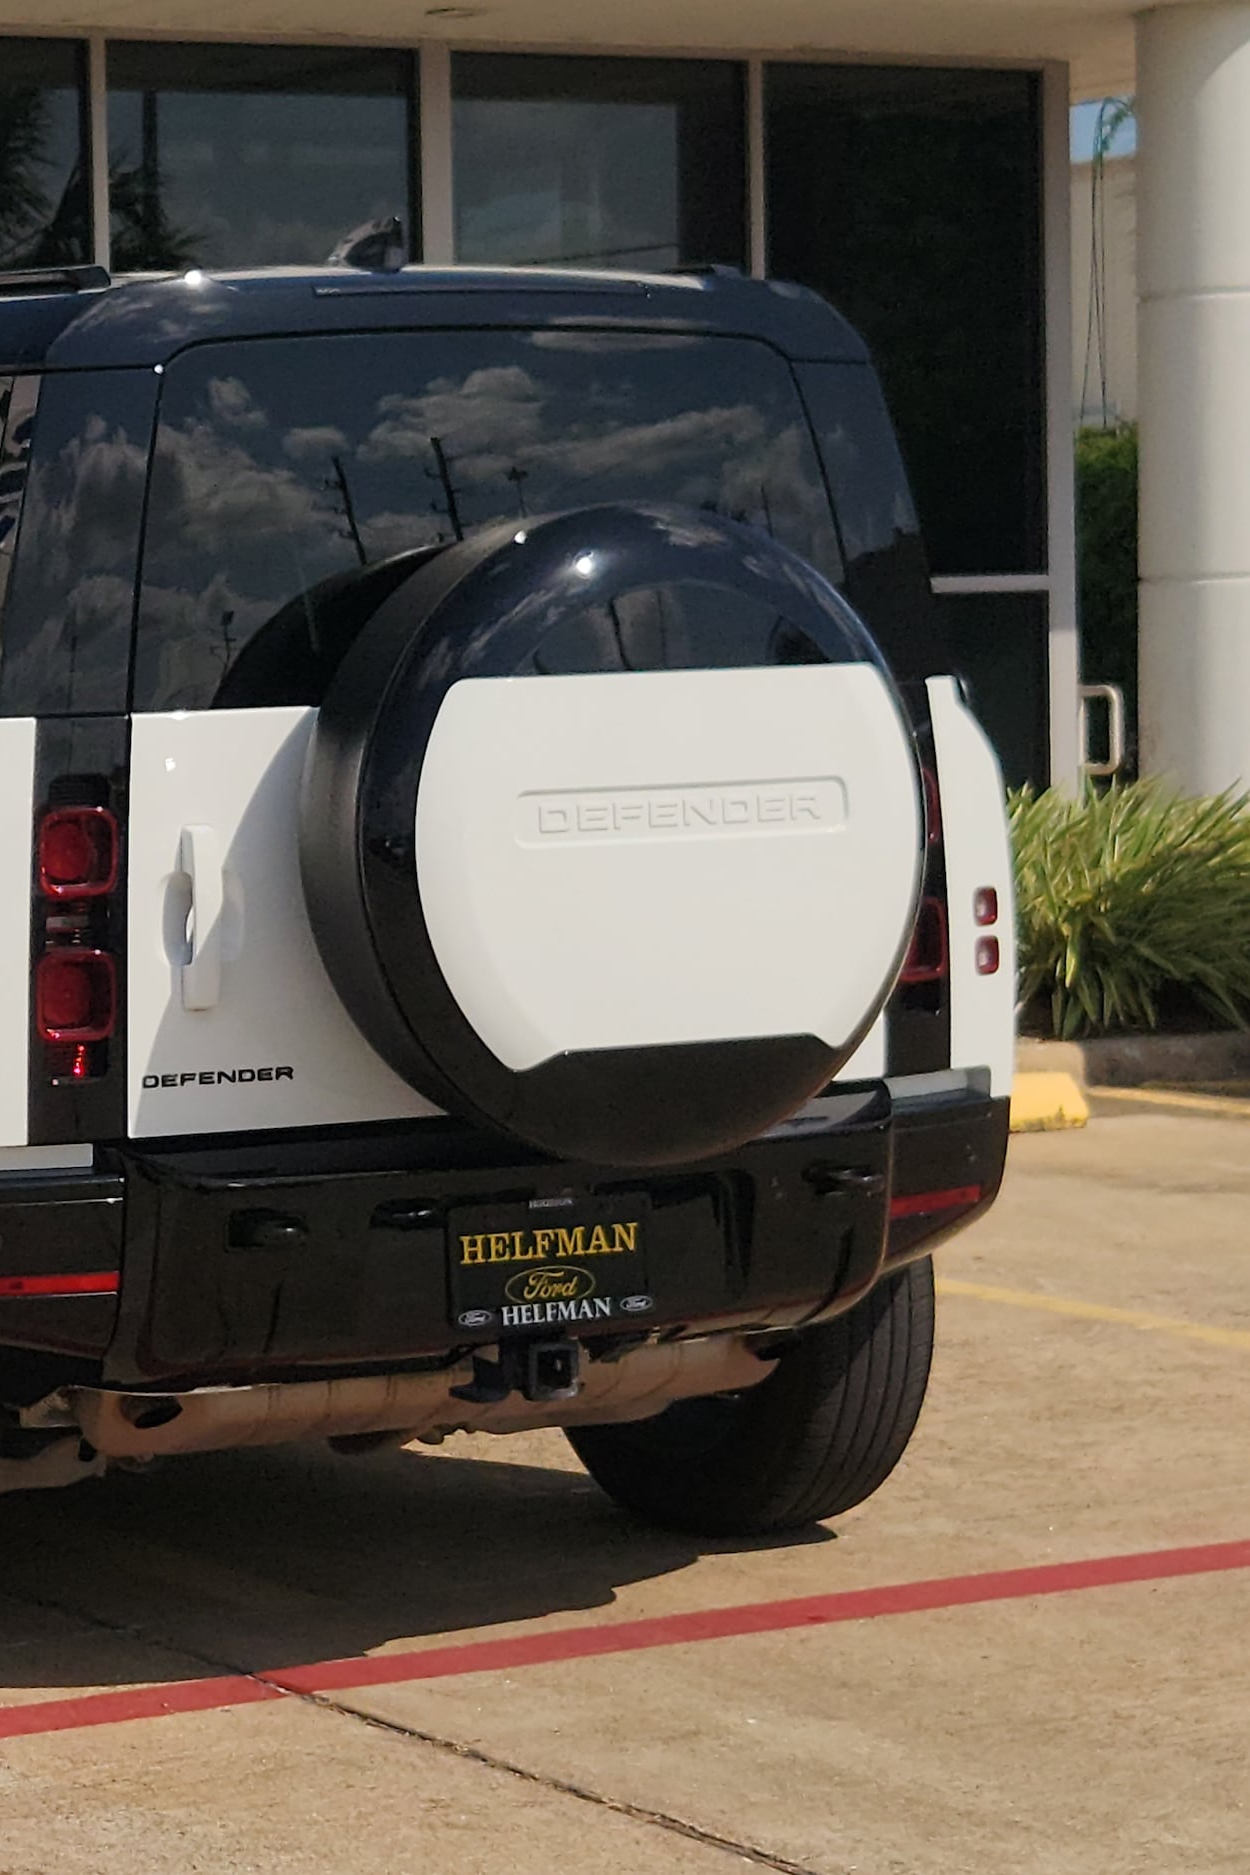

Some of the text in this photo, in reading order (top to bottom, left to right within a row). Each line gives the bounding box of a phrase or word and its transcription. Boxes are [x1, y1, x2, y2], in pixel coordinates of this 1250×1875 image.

[538, 793, 822, 834] DEFENDER
[142, 1066, 294, 1088] DEFENDER
[459, 1222, 638, 1264] HELFMAN
[523, 1271, 579, 1300] Ford
[501, 1297, 613, 1326] HELFMAN
